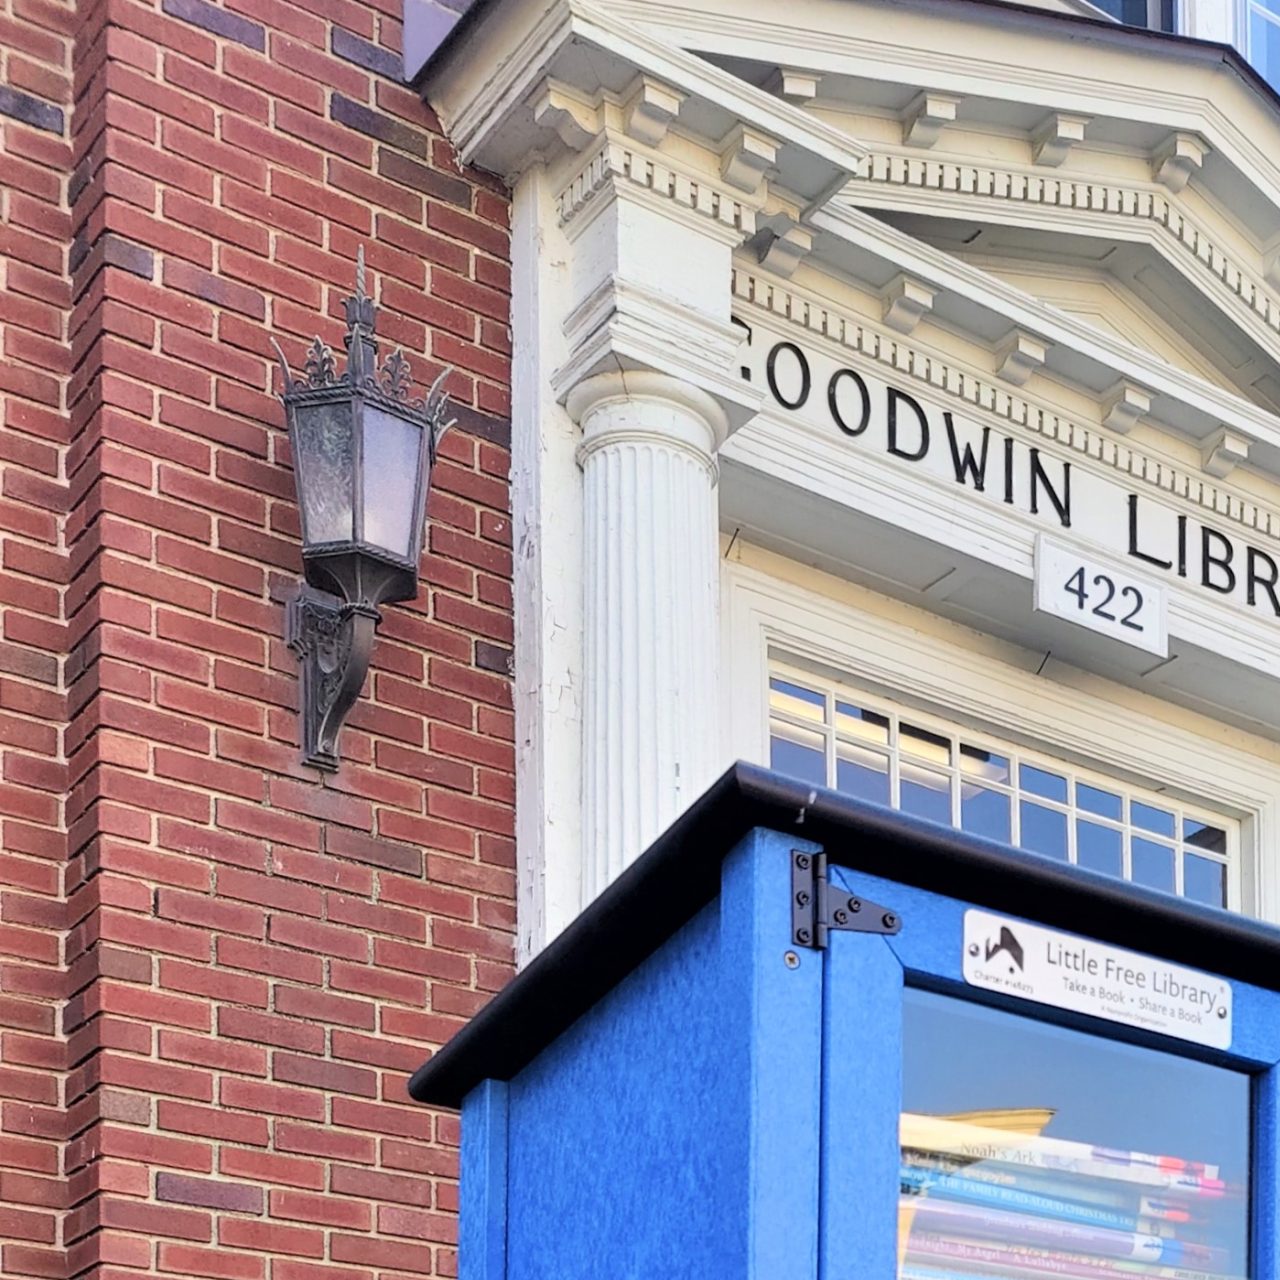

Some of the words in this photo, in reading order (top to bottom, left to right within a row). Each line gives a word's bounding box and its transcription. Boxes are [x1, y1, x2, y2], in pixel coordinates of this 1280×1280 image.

[1063, 566, 1145, 632] 422
[1046, 942, 1098, 976] Little
[1105, 958, 1147, 988] Free
[1153, 971, 1217, 1013] Library
[1063, 976, 1087, 996] Take
[1089, 987, 1096, 997] a
[1099, 987, 1125, 1005] Book
[1139, 996, 1167, 1017] Share
[1169, 1007, 1176, 1018] a
[1178, 1008, 1202, 1025] Book
[961, 1142, 1008, 1161] Noah's
[1013, 1149, 1037, 1164] Ark
[963, 1180, 998, 1197] FAMILY
